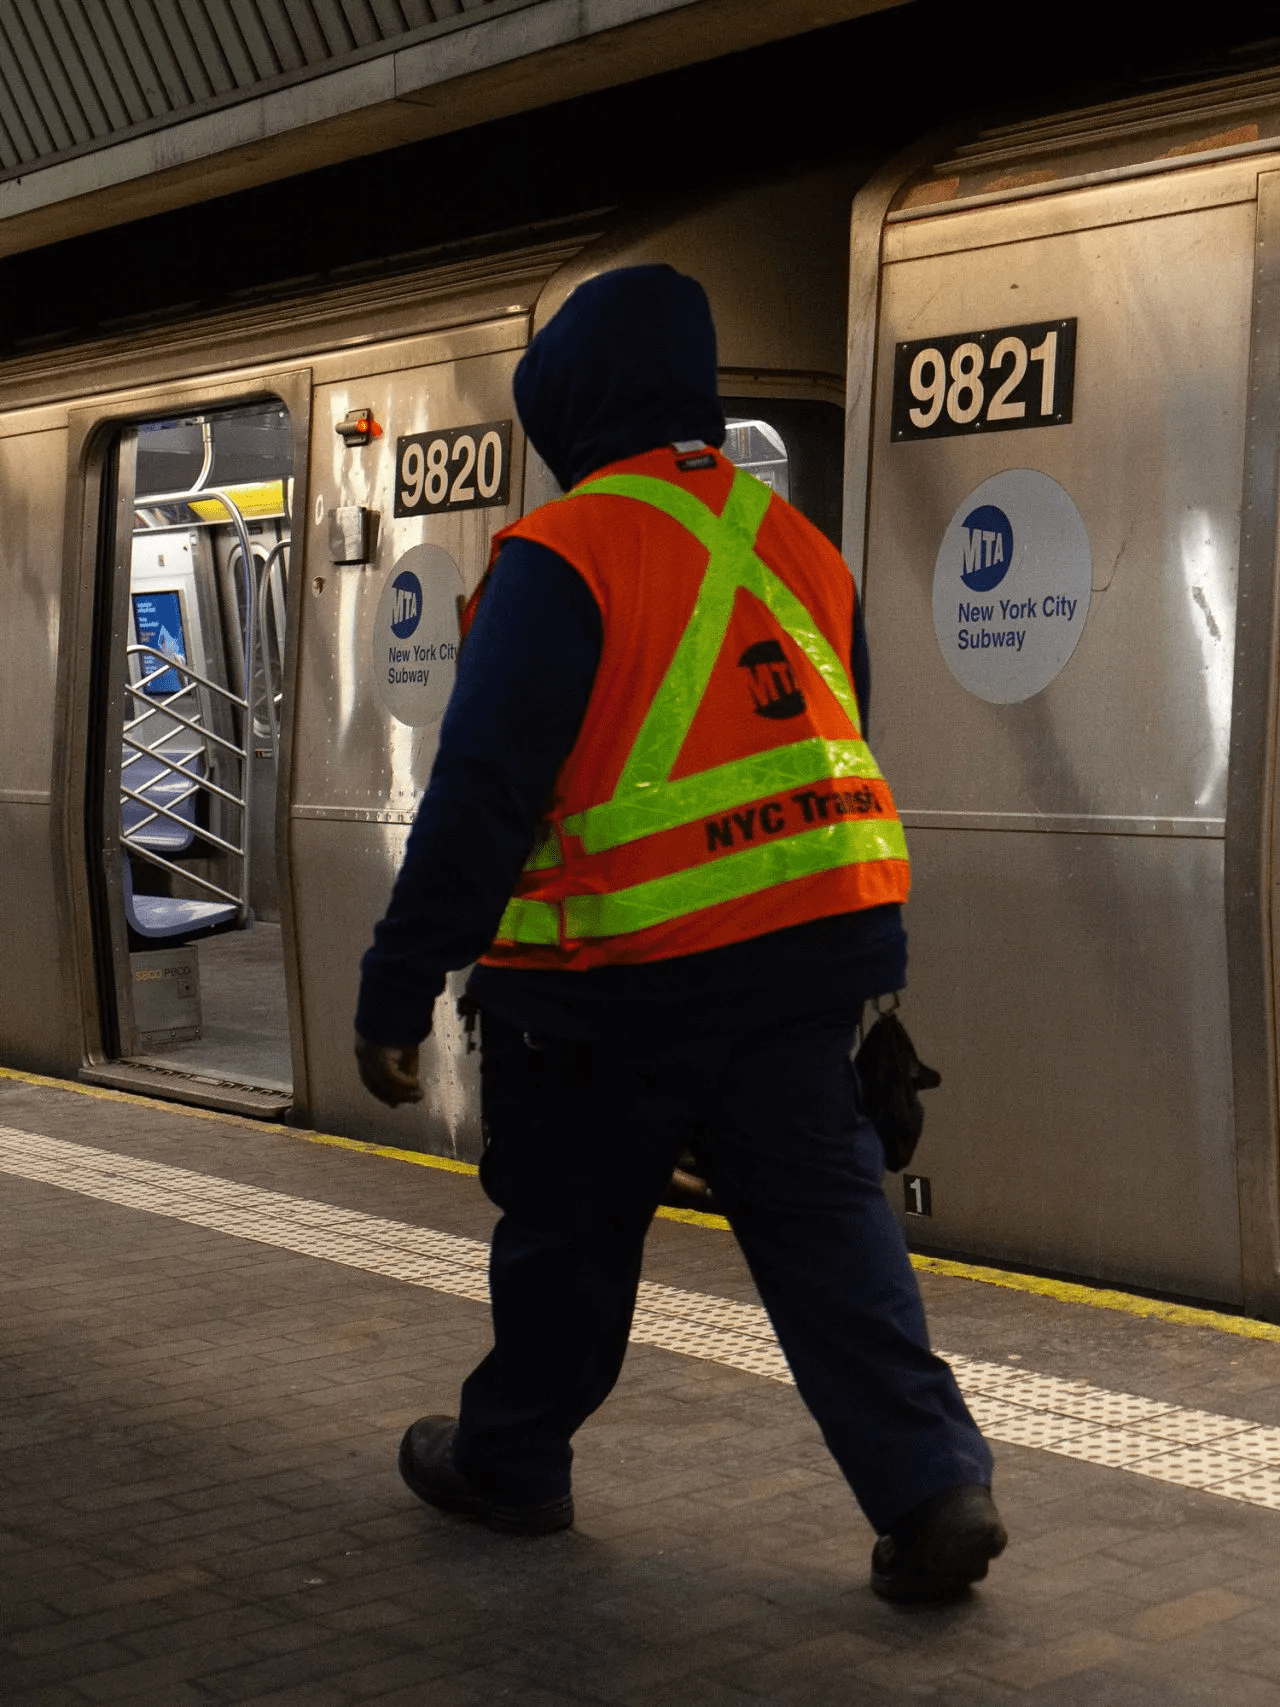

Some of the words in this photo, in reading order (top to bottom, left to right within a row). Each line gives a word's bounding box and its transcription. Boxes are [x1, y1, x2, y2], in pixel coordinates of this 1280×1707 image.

[908, 331, 1058, 429] 9821
[401, 431, 503, 508] 9820
[960, 525, 1005, 578] MTA
[958, 602, 995, 623] New
[999, 597, 1038, 620] York
[1042, 595, 1078, 621] City
[388, 646, 411, 663] New
[412, 643, 437, 661] York
[957, 628, 1026, 652] Subway
[388, 667, 430, 687] Subway
[704, 801, 786, 853] NYC
[790, 784, 884, 824] Trasi
[909, 1177, 923, 1213] 1
